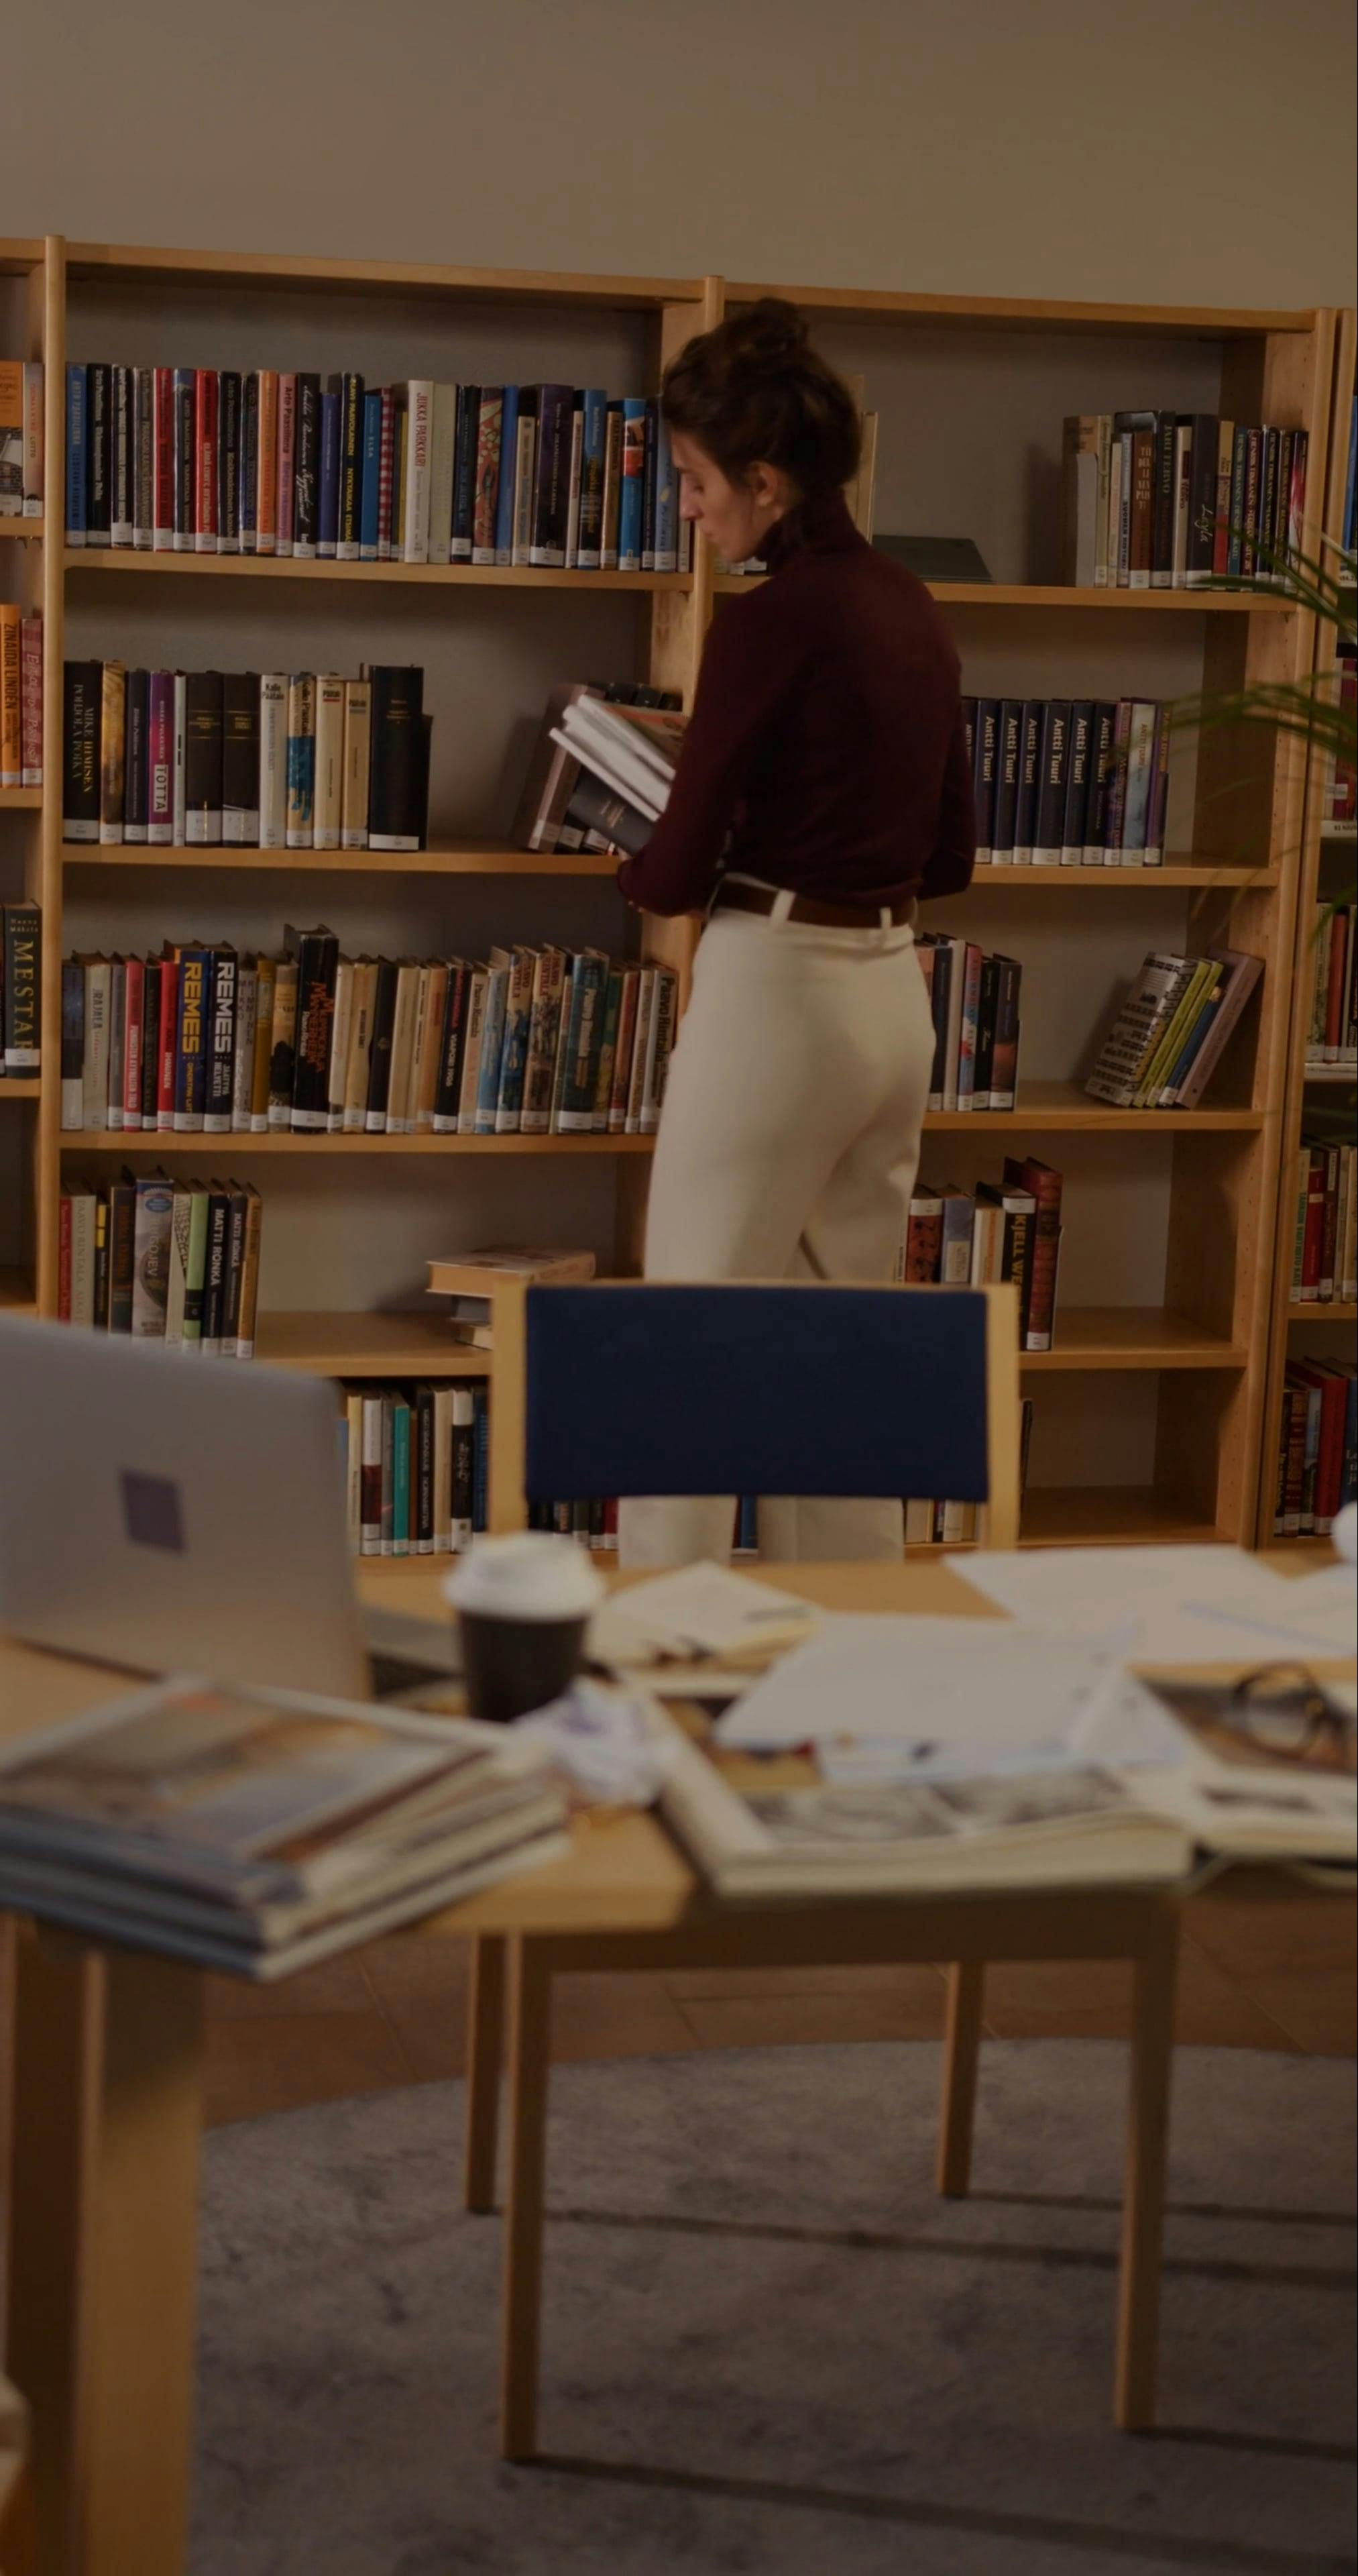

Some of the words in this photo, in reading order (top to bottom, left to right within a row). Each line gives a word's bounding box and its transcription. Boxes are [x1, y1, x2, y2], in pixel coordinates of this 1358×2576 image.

[284, 386, 292, 405] Arto
[416, 392, 428, 421] JUKKA
[283, 408, 292, 453] Paasilinna
[347, 403, 355, 456] PAAVOLAINEN
[414, 425, 427, 467] PARKKARI
[345, 468, 353, 512] NYKYAIKAA
[345, 514, 353, 543] ETSIMÄS
[3, 623, 17, 666] ZINAIDA
[72, 684, 84, 737] POHJOLA
[84, 707, 95, 737] MIKE
[984, 716, 995, 747] Antti
[1007, 718, 1018, 749] Antti
[1027, 718, 1037, 750] Antti
[1052, 718, 1064, 750] Antti
[1076, 718, 1088, 750] Antti
[1100, 718, 1111, 749] Antti
[72, 740, 83, 779] POIKA
[982, 751, 993, 782] Tuuri
[1005, 753, 1016, 784] Tuuri
[1025, 753, 1035, 784] Tuuri
[1050, 753, 1062, 784] Tuuri
[1074, 753, 1085, 784] Tuuri
[1097, 753, 1109, 783] Tuuri
[156, 767, 166, 810] TOTTA
[13, 940, 34, 1049] MESTAR
[182, 961, 203, 1054] REMES
[214, 961, 235, 1054] REMES
[659, 977, 675, 1015] Paavo
[447, 1033, 458, 1067] VIAPORI
[655, 1016, 672, 1063] Rintala
[163, 1052, 172, 1088] IHMINEN
[77, 1200, 87, 1234] PAAVO
[213, 1208, 225, 1243] MATTI
[233, 1213, 241, 1237] MATTI
[1011, 1214, 1027, 1257] KJELL
[76, 1238, 87, 1283] RINTALA
[210, 1246, 223, 1287] RÖNKÄ
[231, 1240, 241, 1268] RÖNKÄ
[1011, 1258, 1024, 1285] WE
